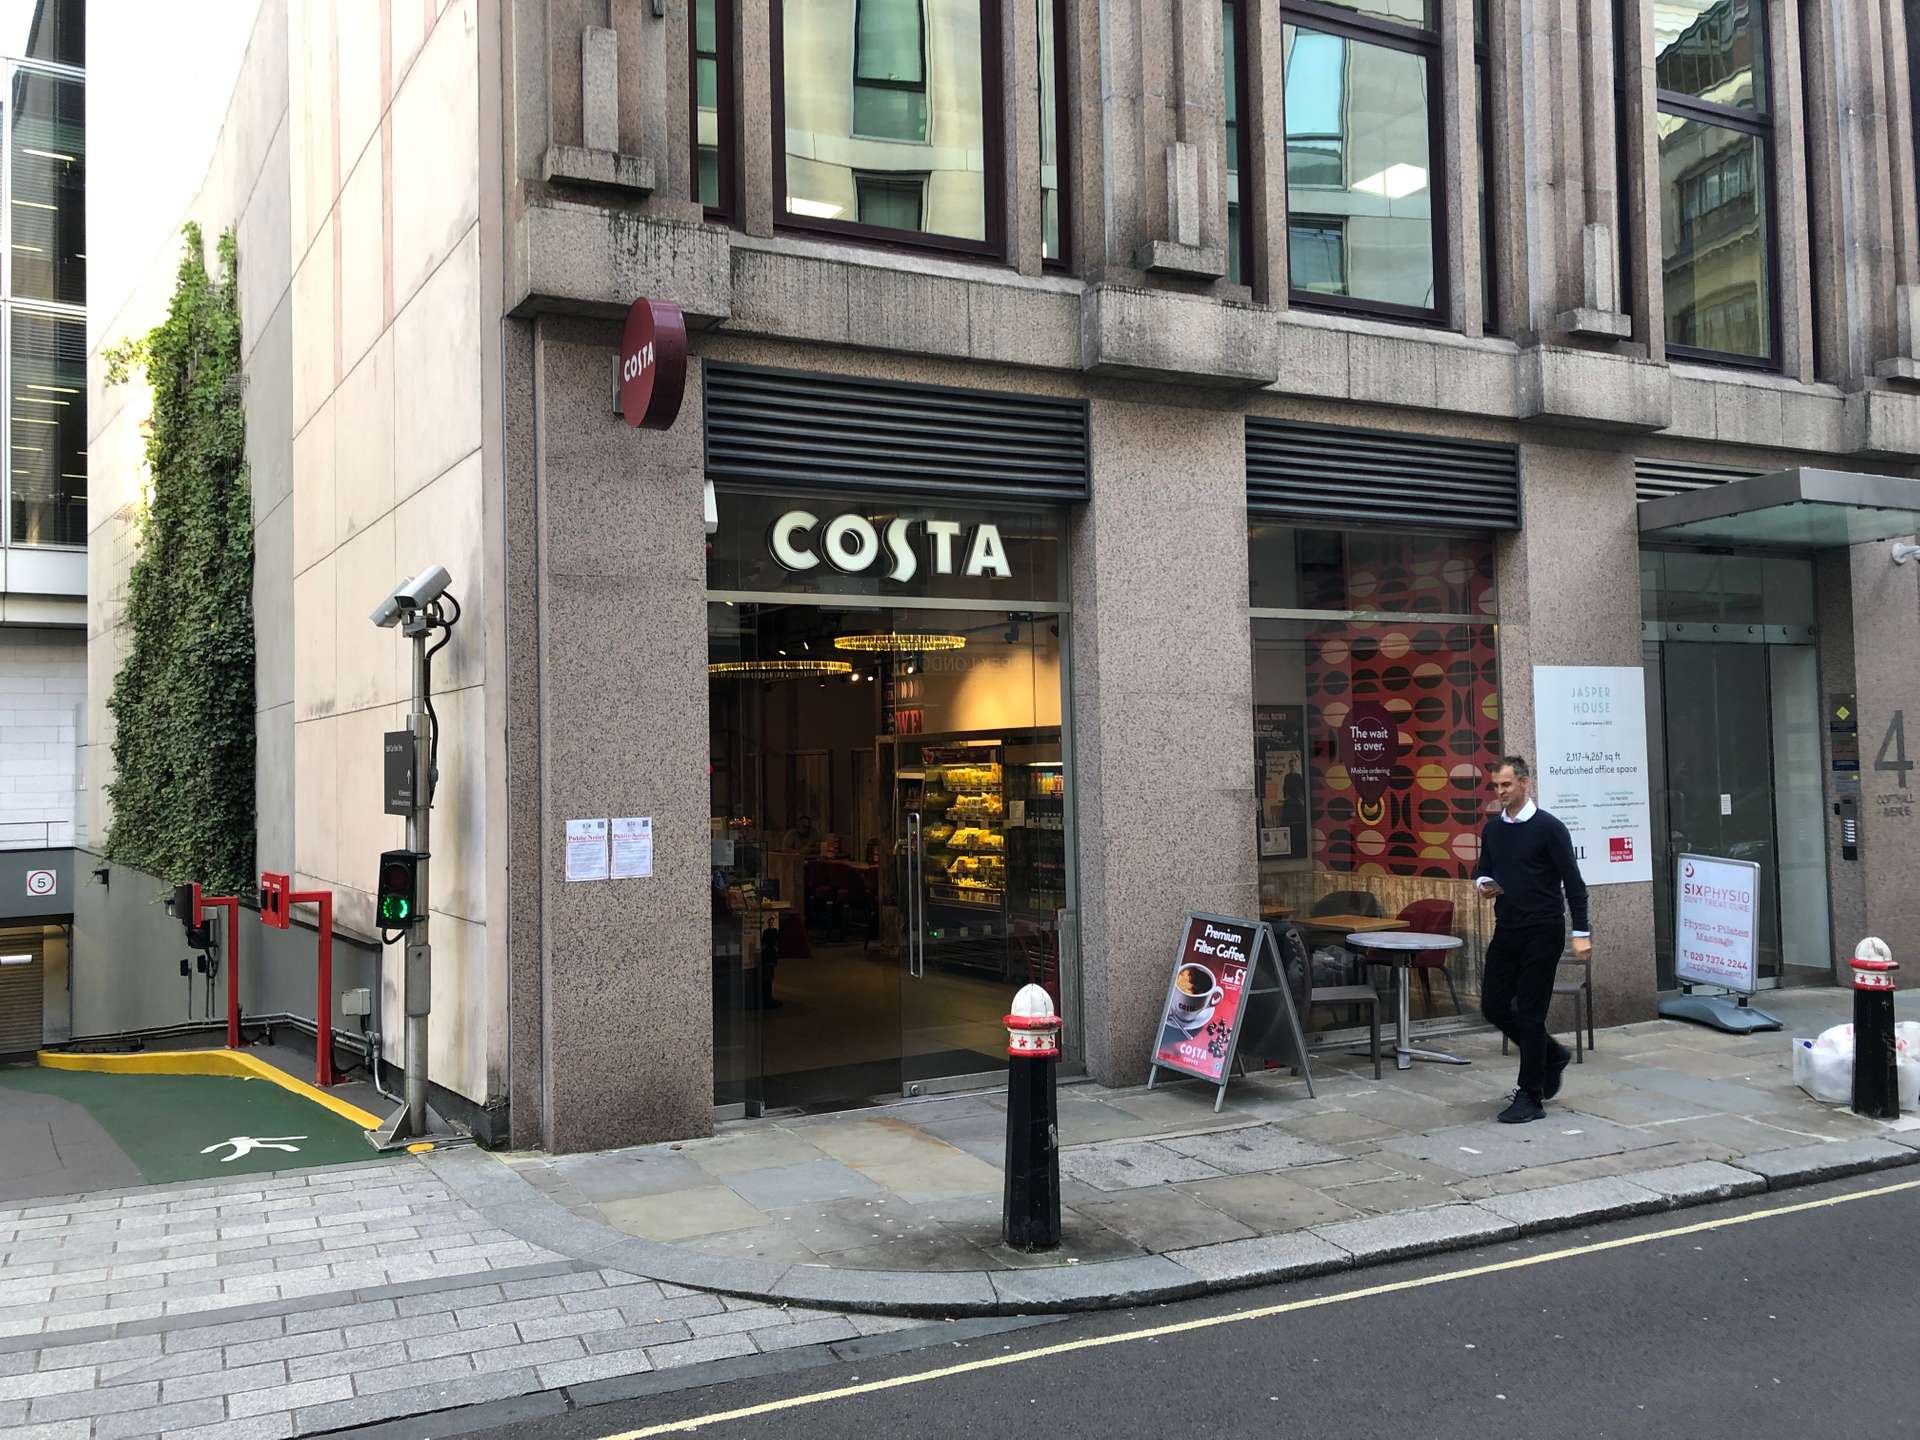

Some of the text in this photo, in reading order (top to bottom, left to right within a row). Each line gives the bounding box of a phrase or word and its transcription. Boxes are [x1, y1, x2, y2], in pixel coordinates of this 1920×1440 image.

[624, 341, 654, 382] COSTA
[770, 510, 1012, 583] COSTA
[1571, 686, 1611, 698] JASPER
[1573, 702, 1611, 713] HOUSE
[1350, 726, 1388, 739] The wait
[1354, 739, 1385, 751] is over.
[1874, 709, 1914, 788] 4
[1604, 755, 1613, 763] sq
[1614, 752, 1621, 761] ft
[1369, 767, 1390, 777] ordering
[1549, 764, 1638, 776] Refurbished office space
[1573, 846, 1588, 860] LL
[37, 877, 46, 888] 5
[1205, 924, 1241, 944] Premium
[1194, 938, 1246, 962] Filter Coffee.
[1690, 951, 1704, 962] 020
[1180, 1043, 1207, 1060] COSTA
